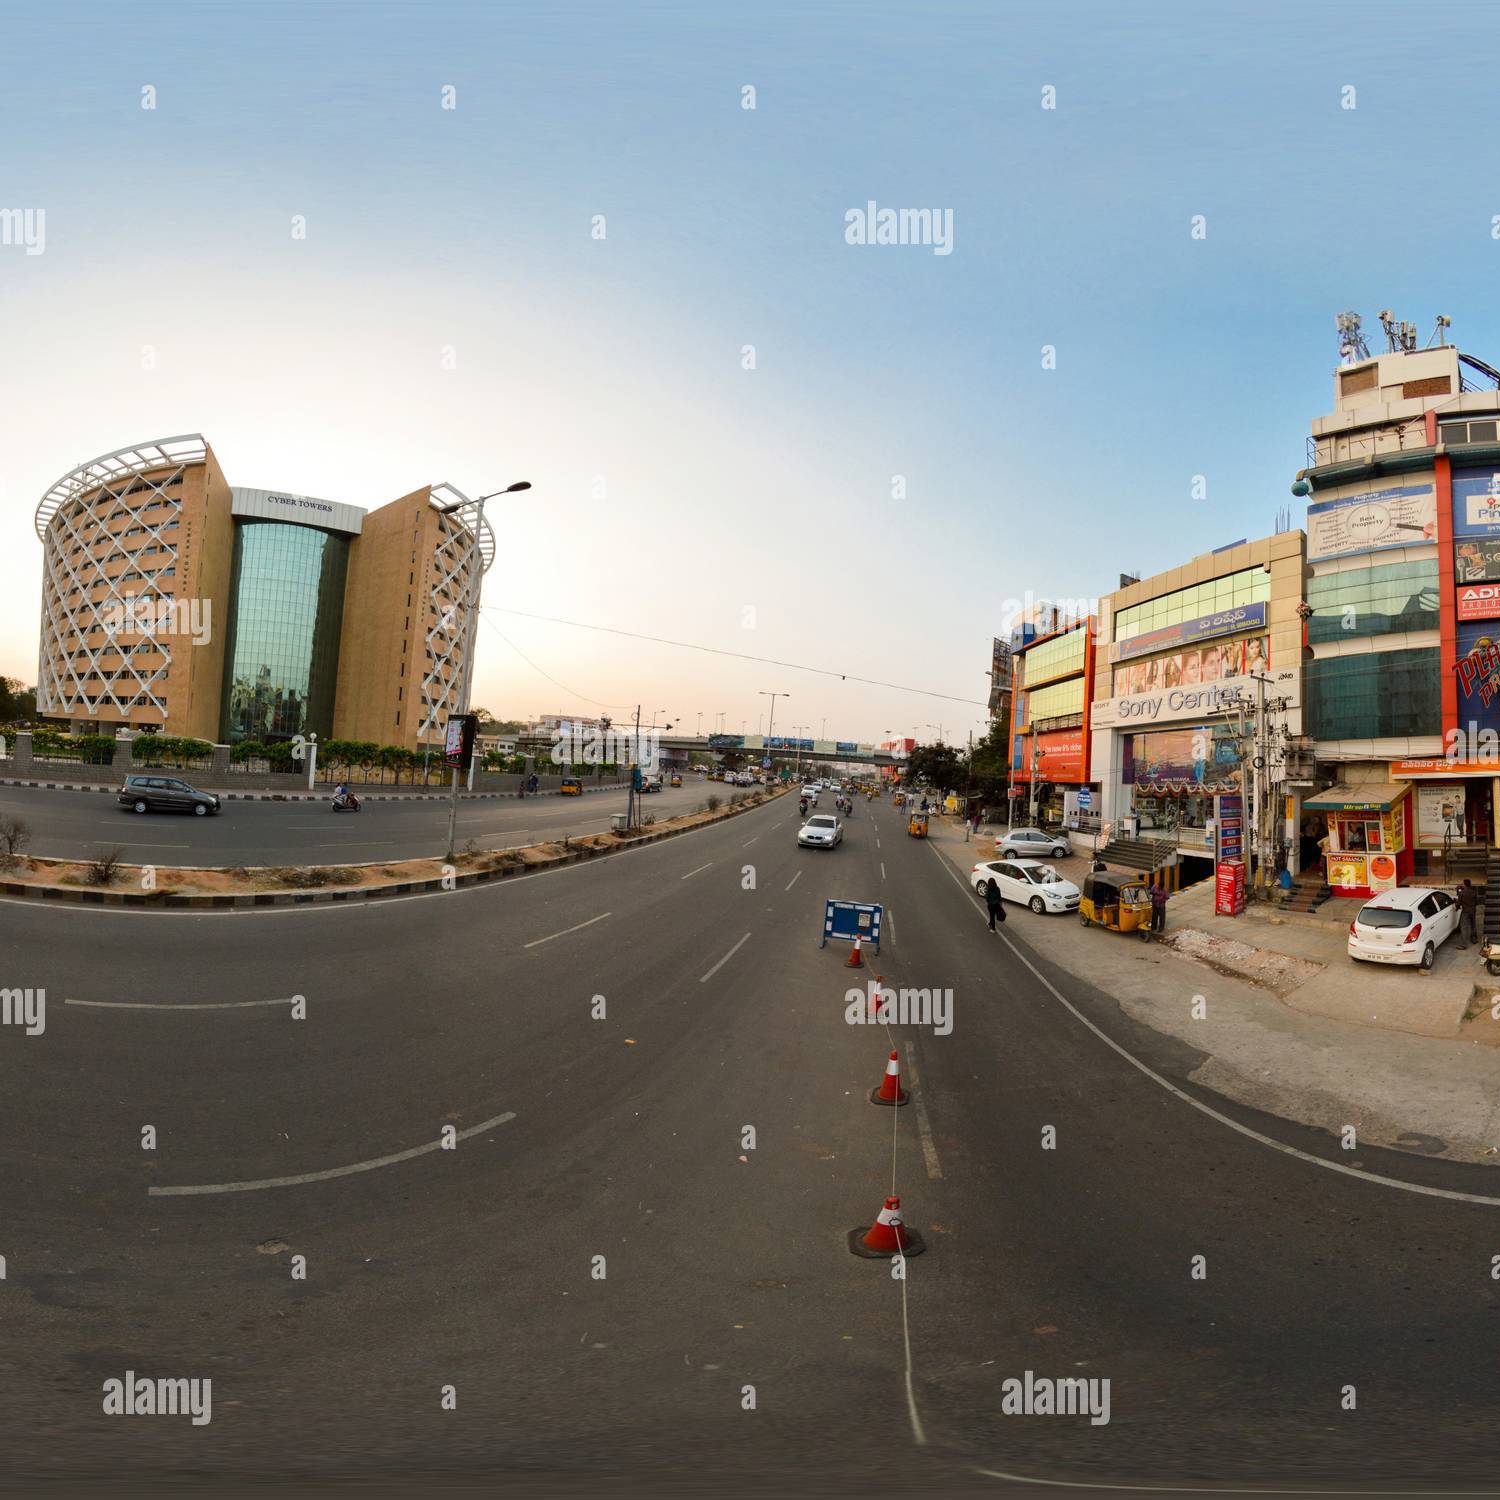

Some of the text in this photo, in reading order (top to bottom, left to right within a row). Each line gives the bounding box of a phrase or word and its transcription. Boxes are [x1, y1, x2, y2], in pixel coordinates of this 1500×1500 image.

[267, 495, 333, 512] CYBER TOWERS
[1351, 519, 1384, 529] Property
[1118, 684, 1244, 719] Sony Center
